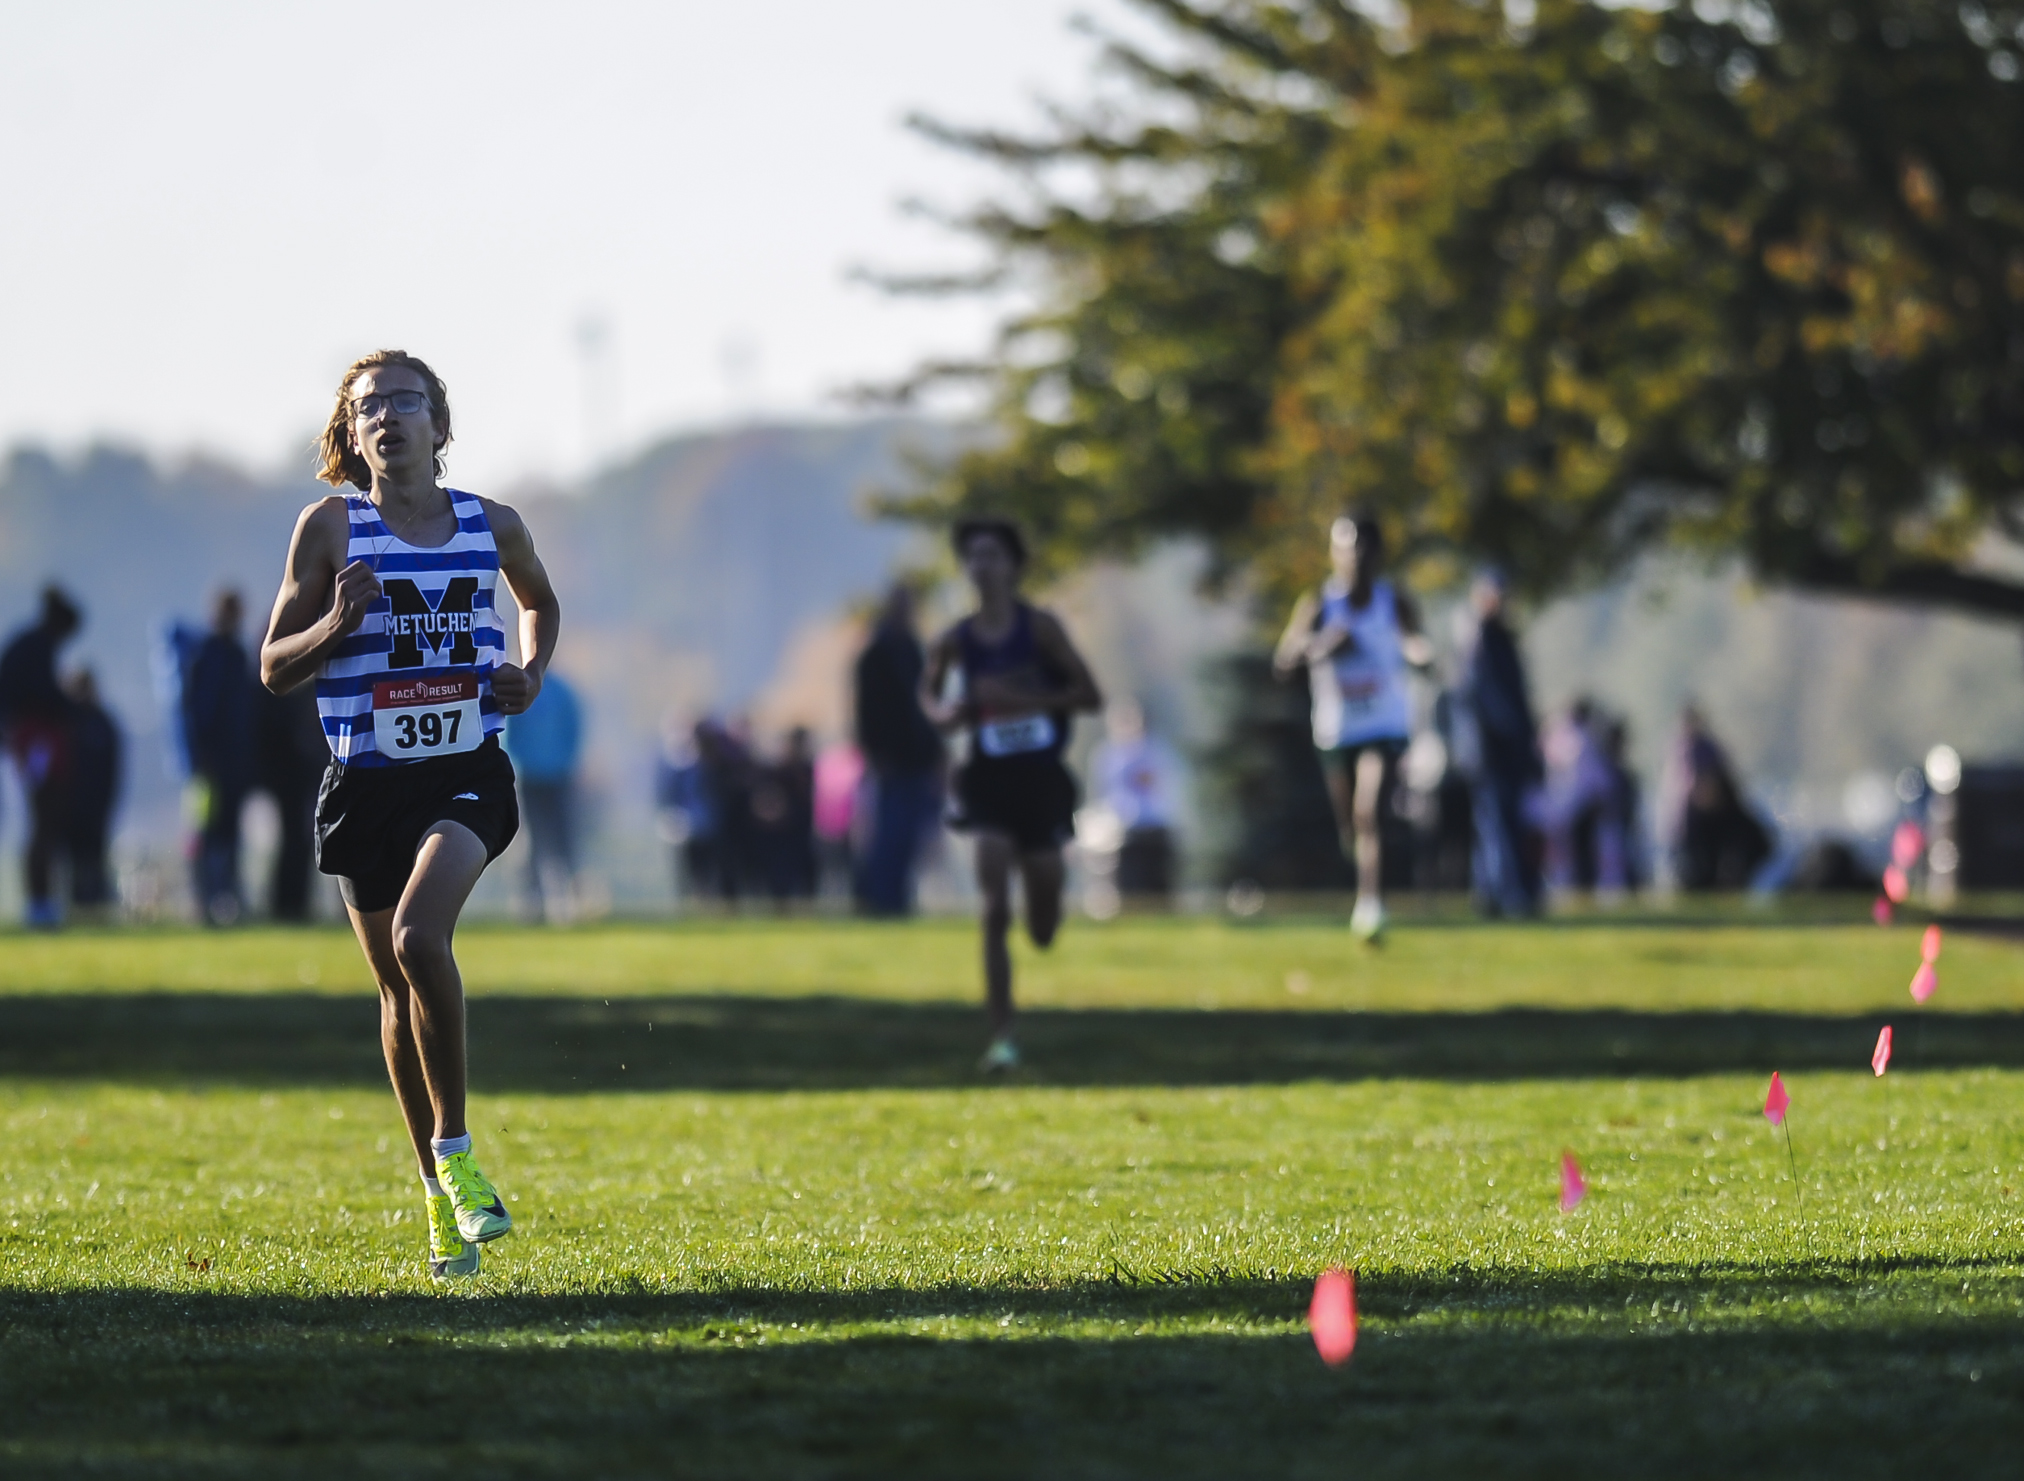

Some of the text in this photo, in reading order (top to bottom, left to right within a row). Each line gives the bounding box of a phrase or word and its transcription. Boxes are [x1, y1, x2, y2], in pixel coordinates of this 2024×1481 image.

[384, 612, 477, 636] METUCHEN
[389, 688, 416, 700] RACE
[429, 683, 463, 697] RESULT
[394, 709, 463, 749] 397
